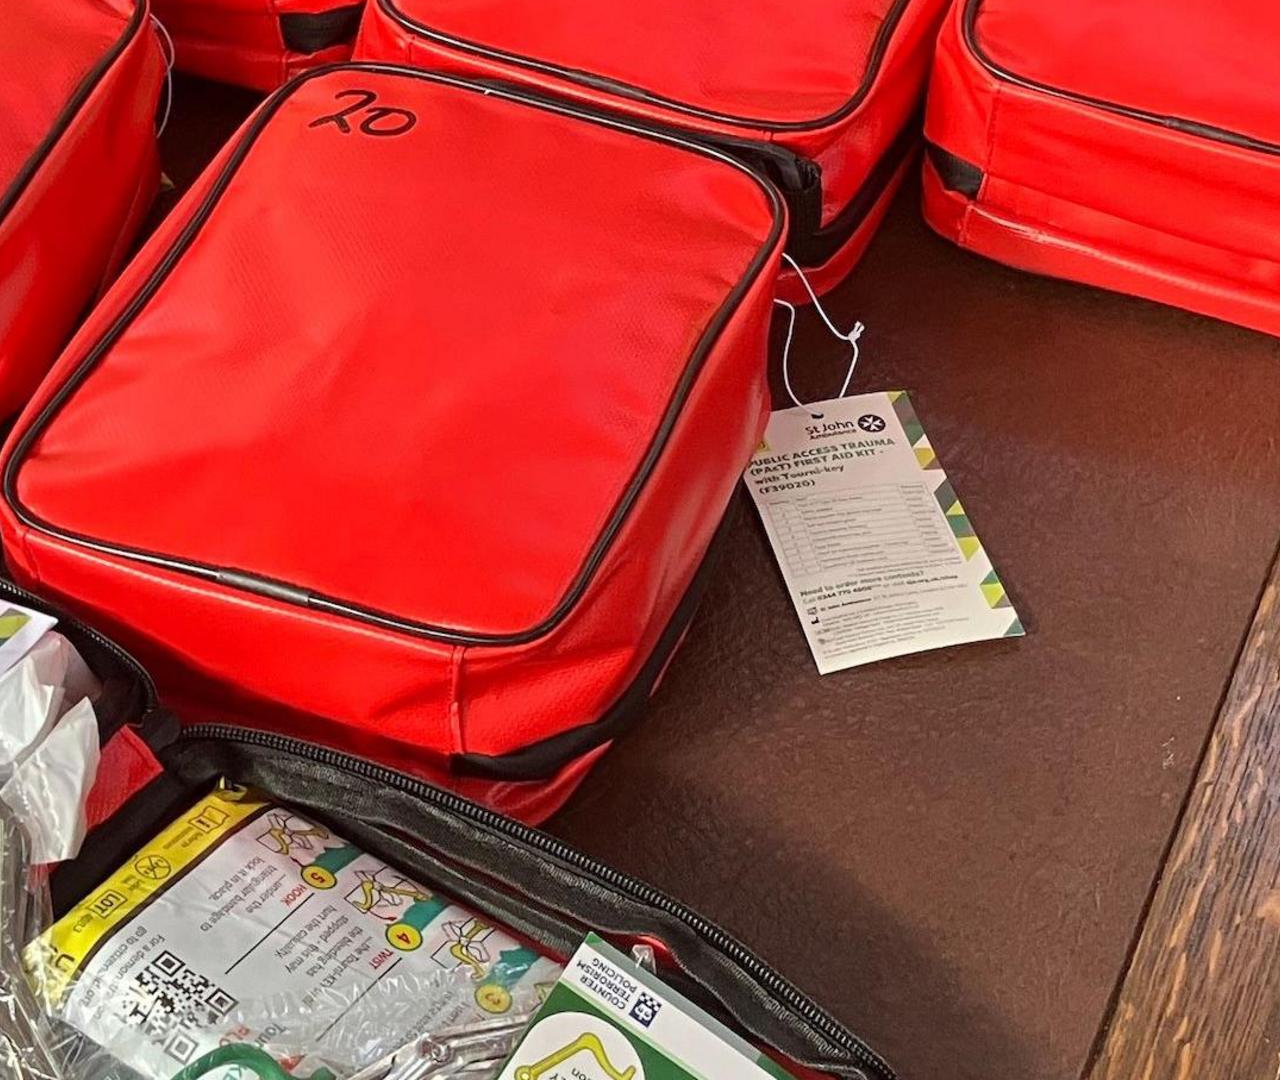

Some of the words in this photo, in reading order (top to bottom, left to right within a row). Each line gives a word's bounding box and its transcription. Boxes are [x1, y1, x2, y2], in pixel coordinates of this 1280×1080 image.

[308, 89, 417, 137] 20
[805, 426, 820, 436] St
[821, 420, 855, 432] John
[792, 445, 840, 460] ACCESS
[840, 438, 896, 453] TRAUMA
[793, 456, 828, 468] FIRST
[831, 451, 855, 462] AID
[855, 449, 877, 459] KIT
[754, 475, 780, 486] with
[310, 872, 327, 884] 5
[93, 893, 121, 917] LOT
[279, 883, 309, 908] HOOK
[396, 932, 412, 945] 4
[369, 947, 395, 971] TWIST
[576, 960, 632, 1003] TERRORISM
[591, 958, 638, 994] POLICING
[579, 975, 627, 1011] COUNTER
